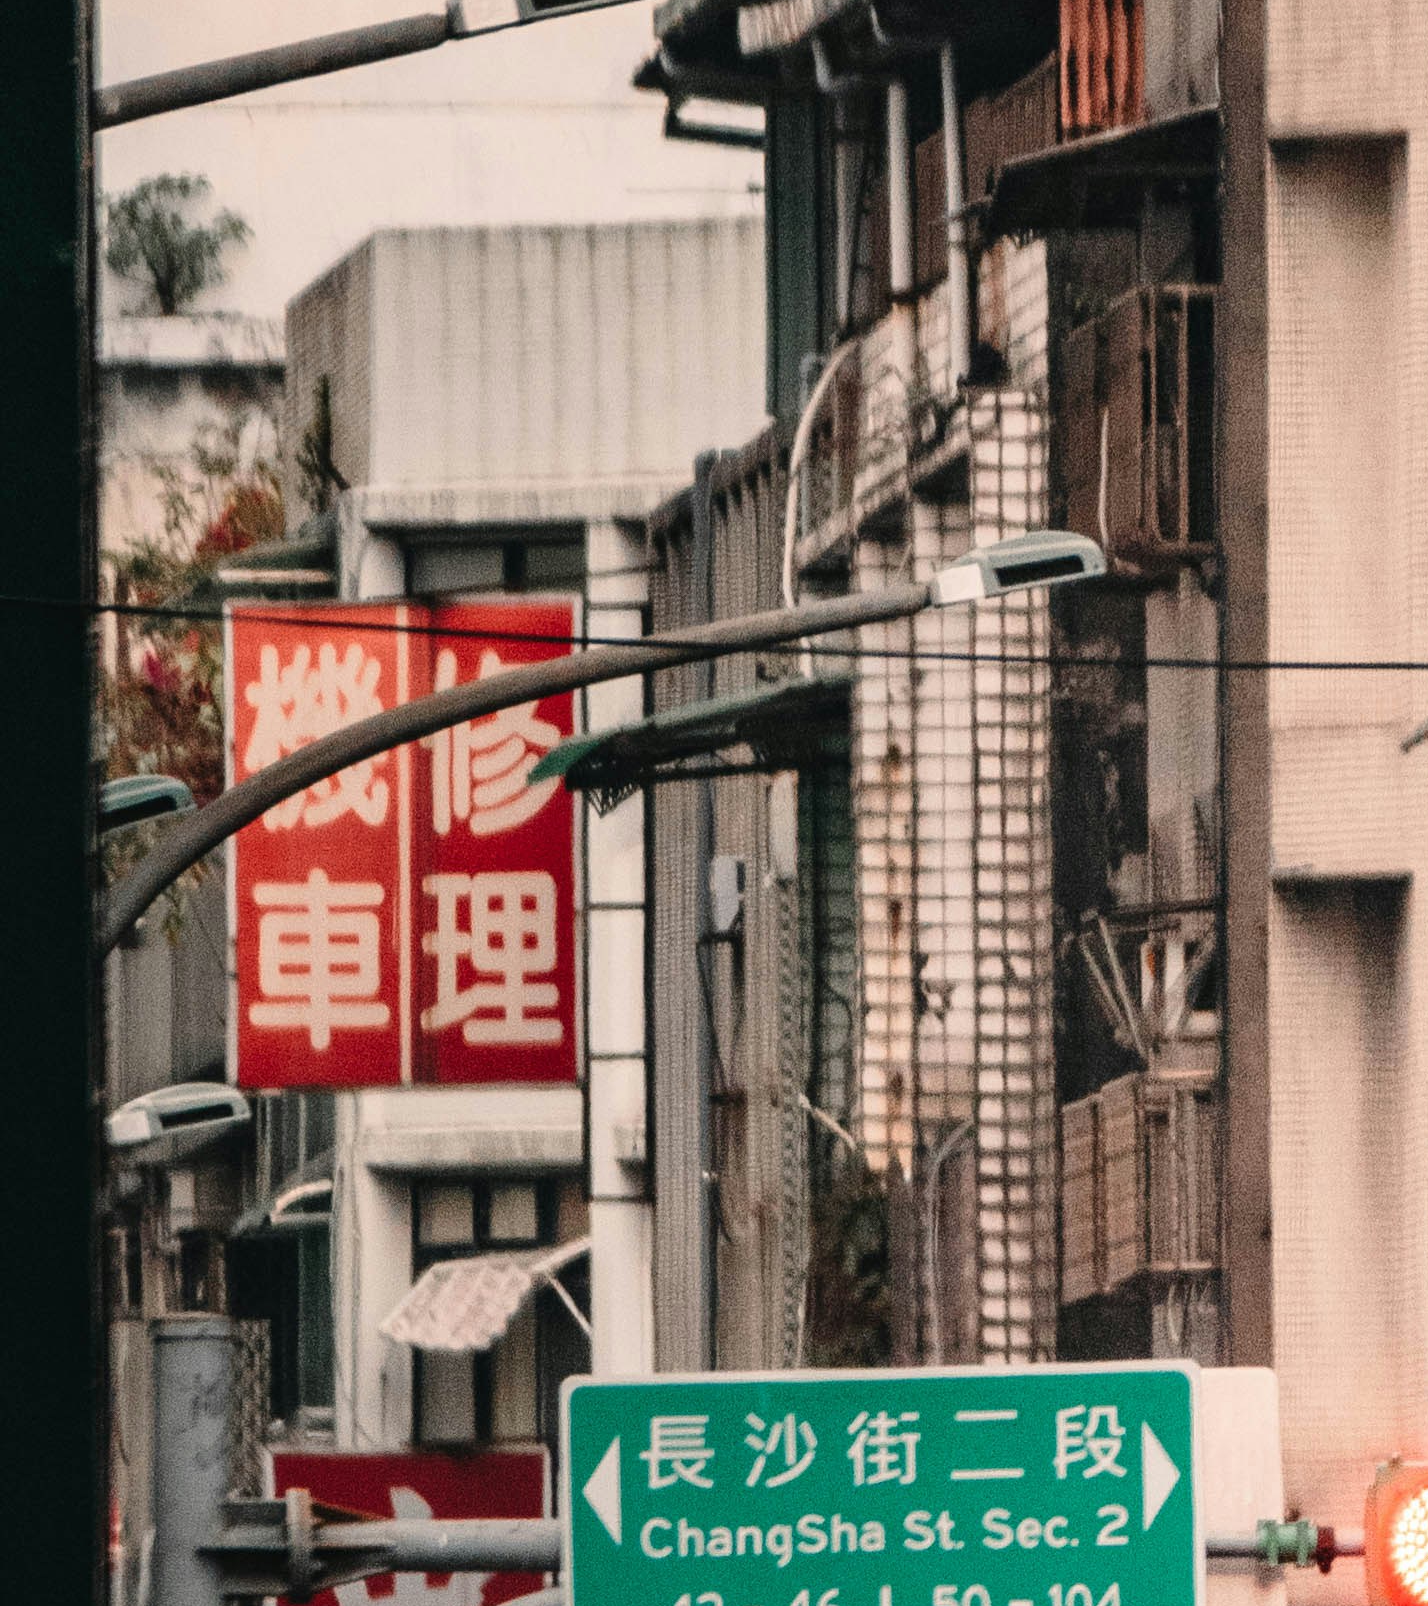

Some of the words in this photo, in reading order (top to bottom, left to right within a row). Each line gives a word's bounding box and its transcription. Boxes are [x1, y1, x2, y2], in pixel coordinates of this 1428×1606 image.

[245, 642, 391, 1051] 機車
[418, 642, 568, 1049] 修理
[640, 1405, 1127, 1489] 長沙街二段
[641, 1514, 885, 1567] ChangSha
[904, 1510, 964, 1550] St.
[982, 1508, 1079, 1549] Sec.
[1096, 1504, 1128, 1546] 2
